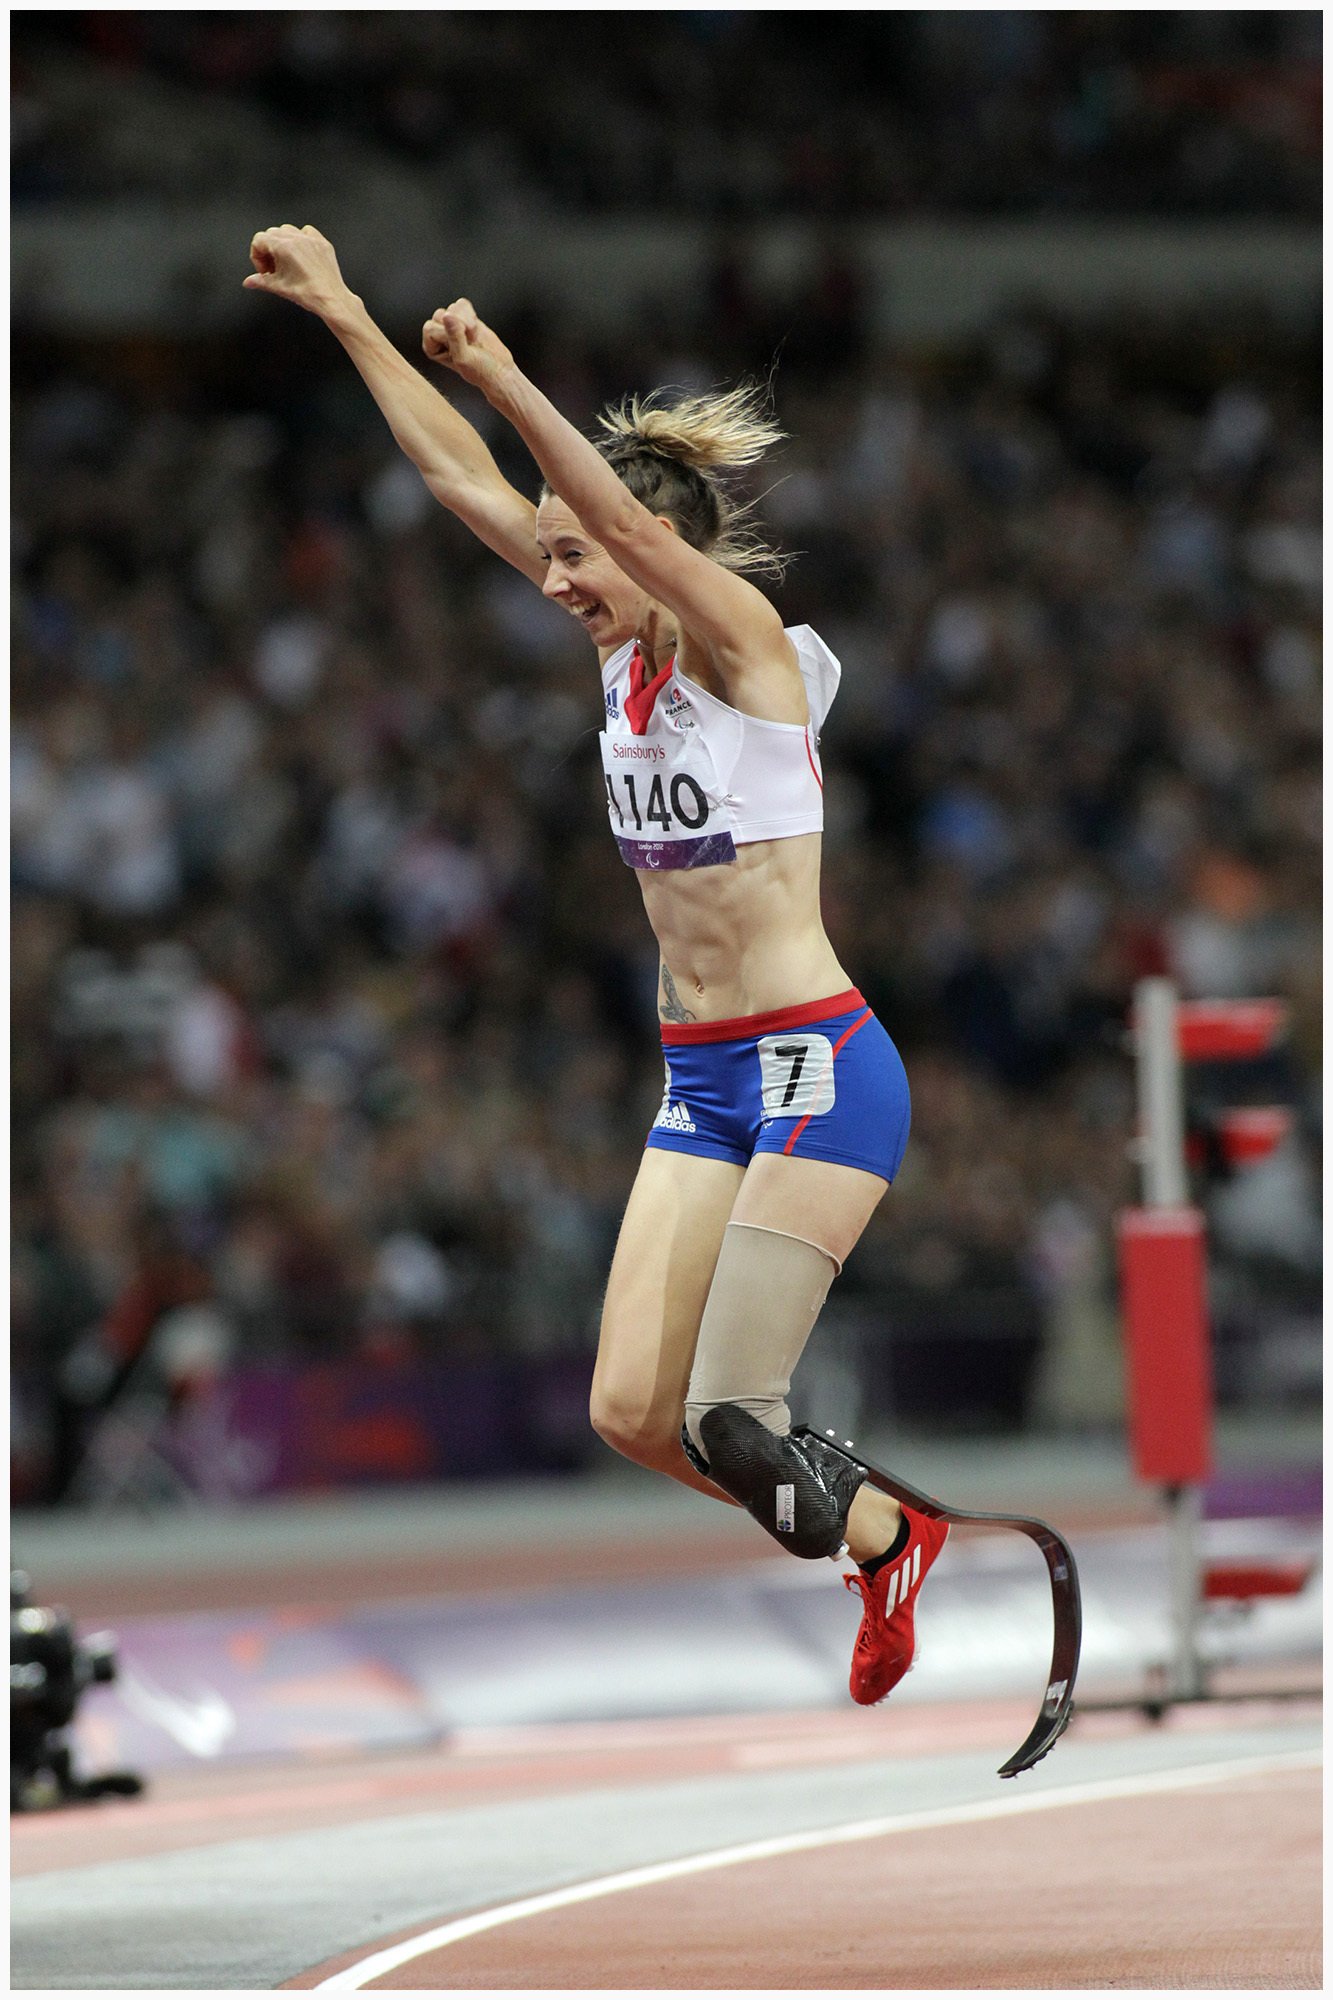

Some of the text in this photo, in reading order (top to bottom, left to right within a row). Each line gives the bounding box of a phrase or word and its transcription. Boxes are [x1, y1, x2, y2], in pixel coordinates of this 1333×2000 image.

[613, 743, 666, 763] Sainsbury's
[774, 1046, 808, 1107] 7
[660, 1117, 696, 1133] adidas
